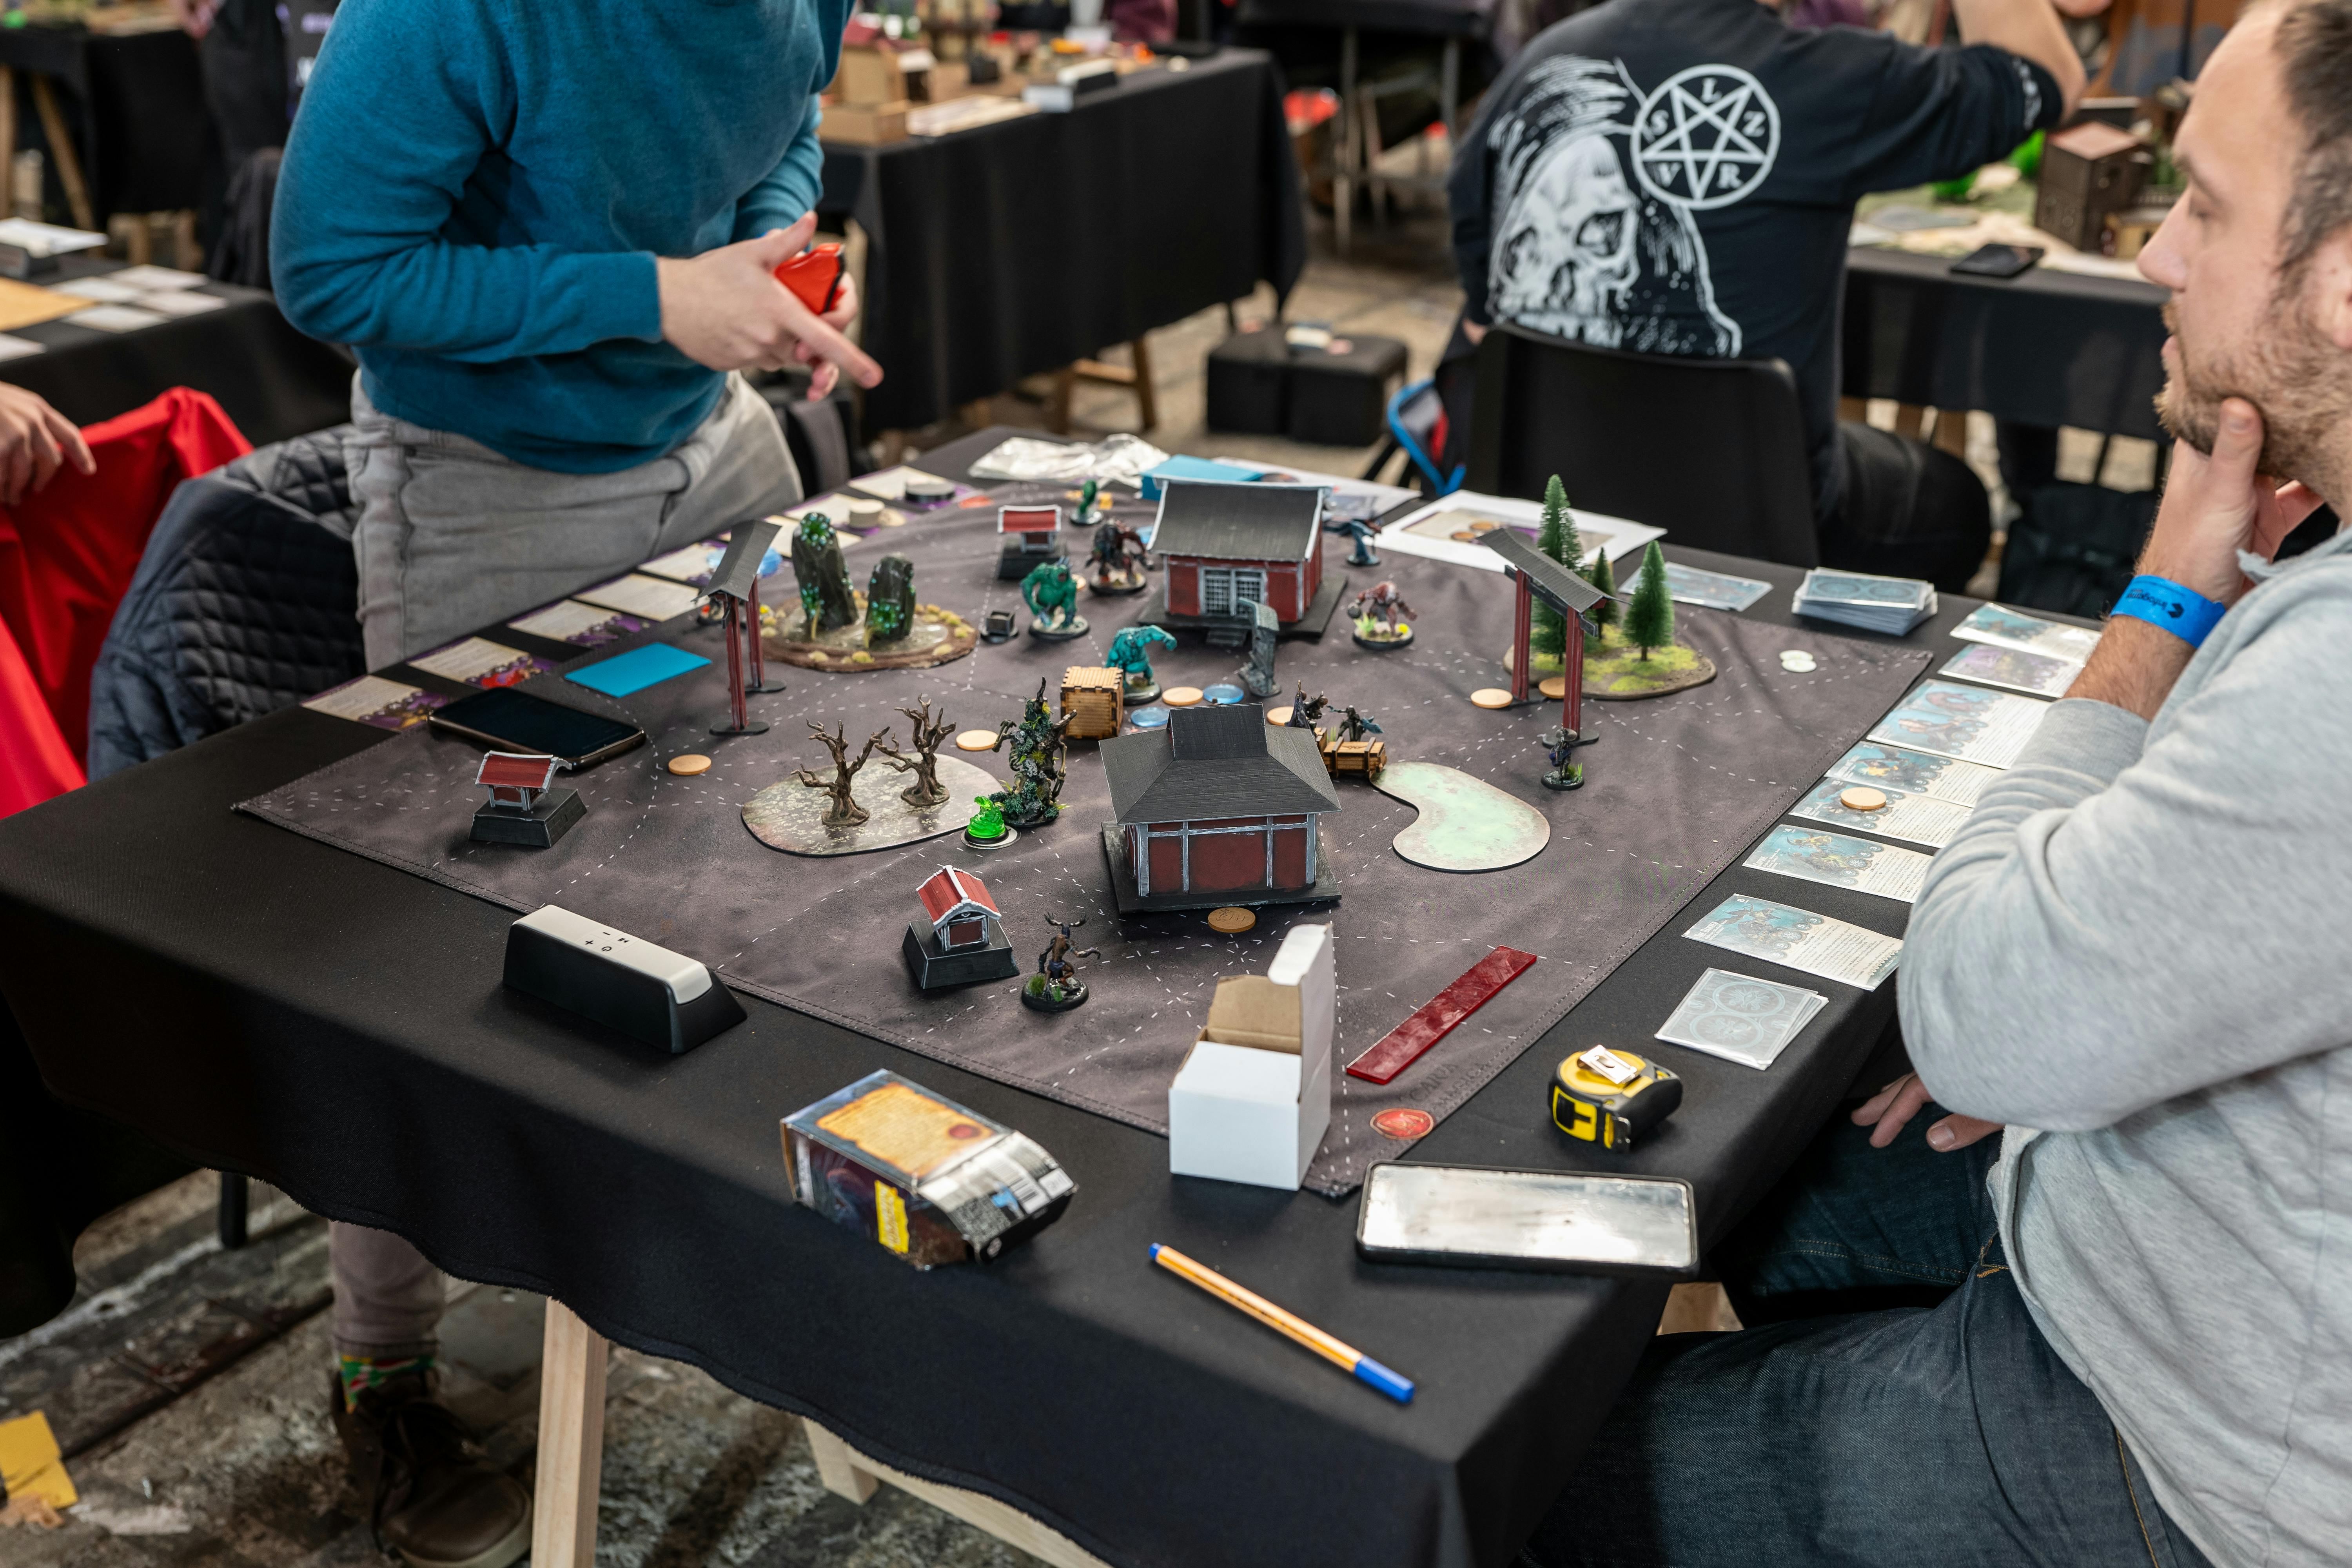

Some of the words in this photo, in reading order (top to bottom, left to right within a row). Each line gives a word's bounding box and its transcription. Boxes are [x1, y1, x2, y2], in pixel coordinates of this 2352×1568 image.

[1701, 78, 1723, 103] L
[1651, 109, 1669, 136] S
[1742, 110, 1766, 137] Z
[1648, 162, 1682, 187] V
[1717, 162, 1743, 189] R
